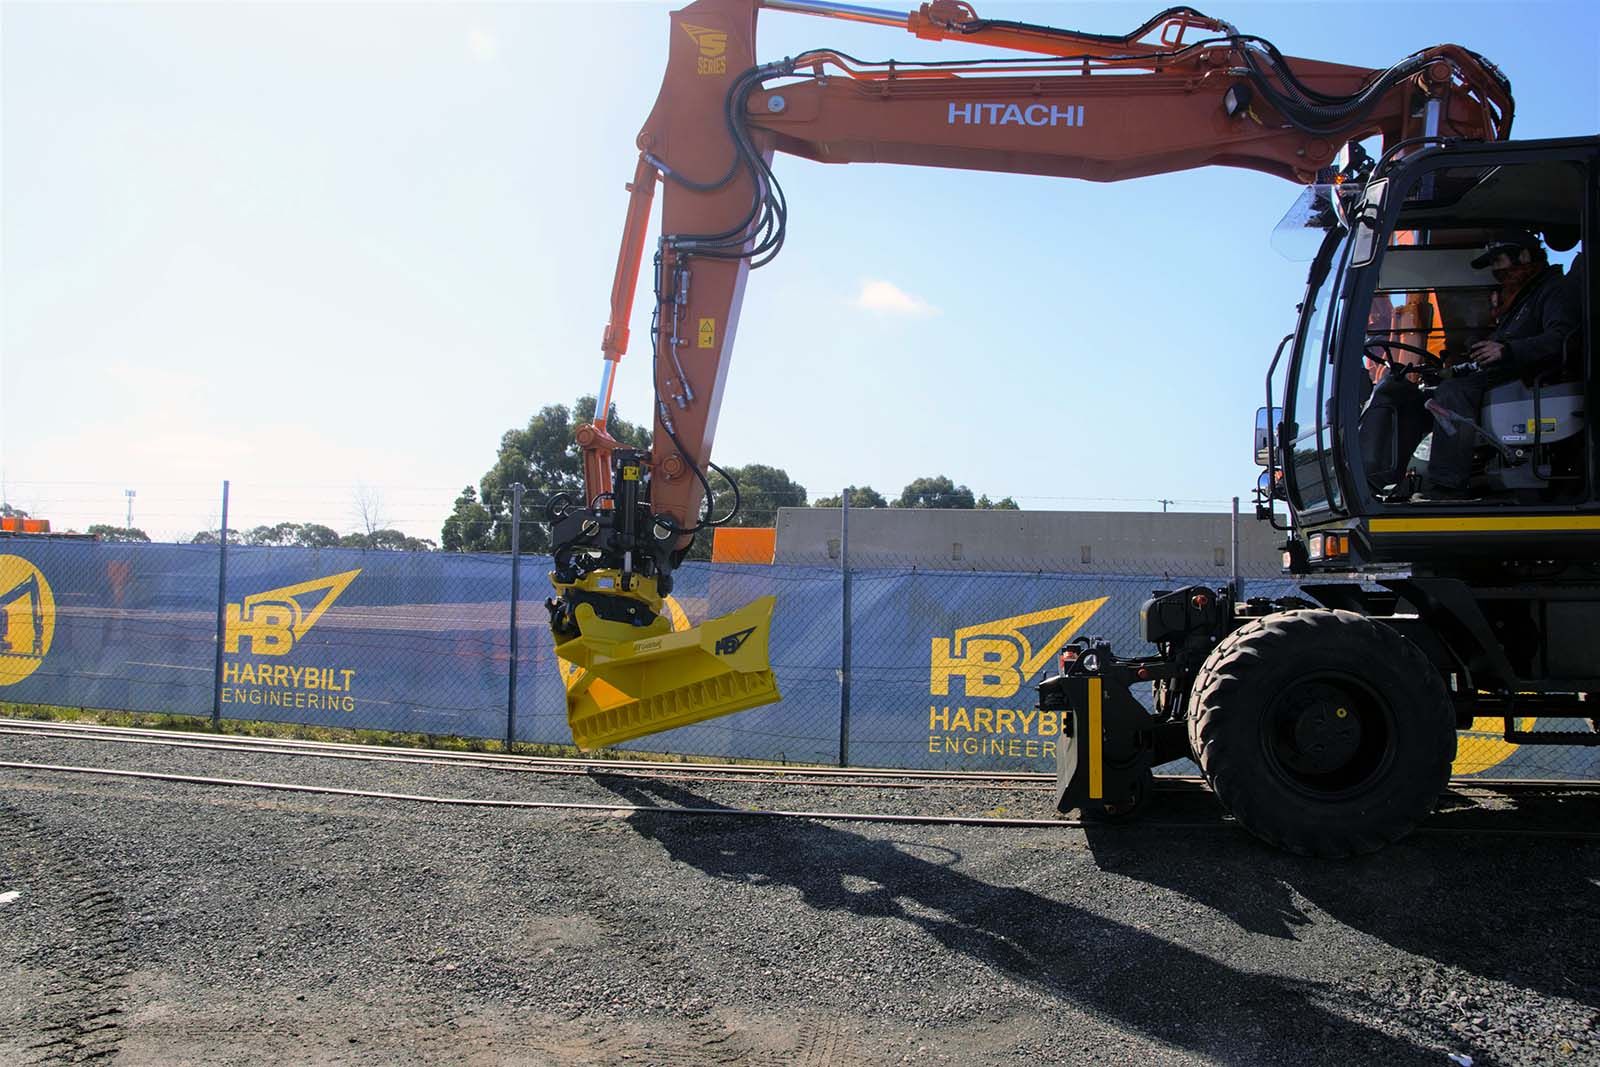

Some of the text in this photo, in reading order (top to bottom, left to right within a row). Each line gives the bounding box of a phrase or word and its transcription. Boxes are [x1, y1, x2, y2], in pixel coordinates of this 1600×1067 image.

[697, 56, 727, 76] SERIES
[947, 102, 1085, 127] HITACHI
[224, 602, 294, 656] HB
[222, 661, 356, 692] HARRYBILT
[930, 637, 1021, 698] HB
[221, 687, 355, 712] ENGINEERING
[929, 705, 1067, 736] HARRYBI
[928, 735, 1057, 758] ENGINEER
